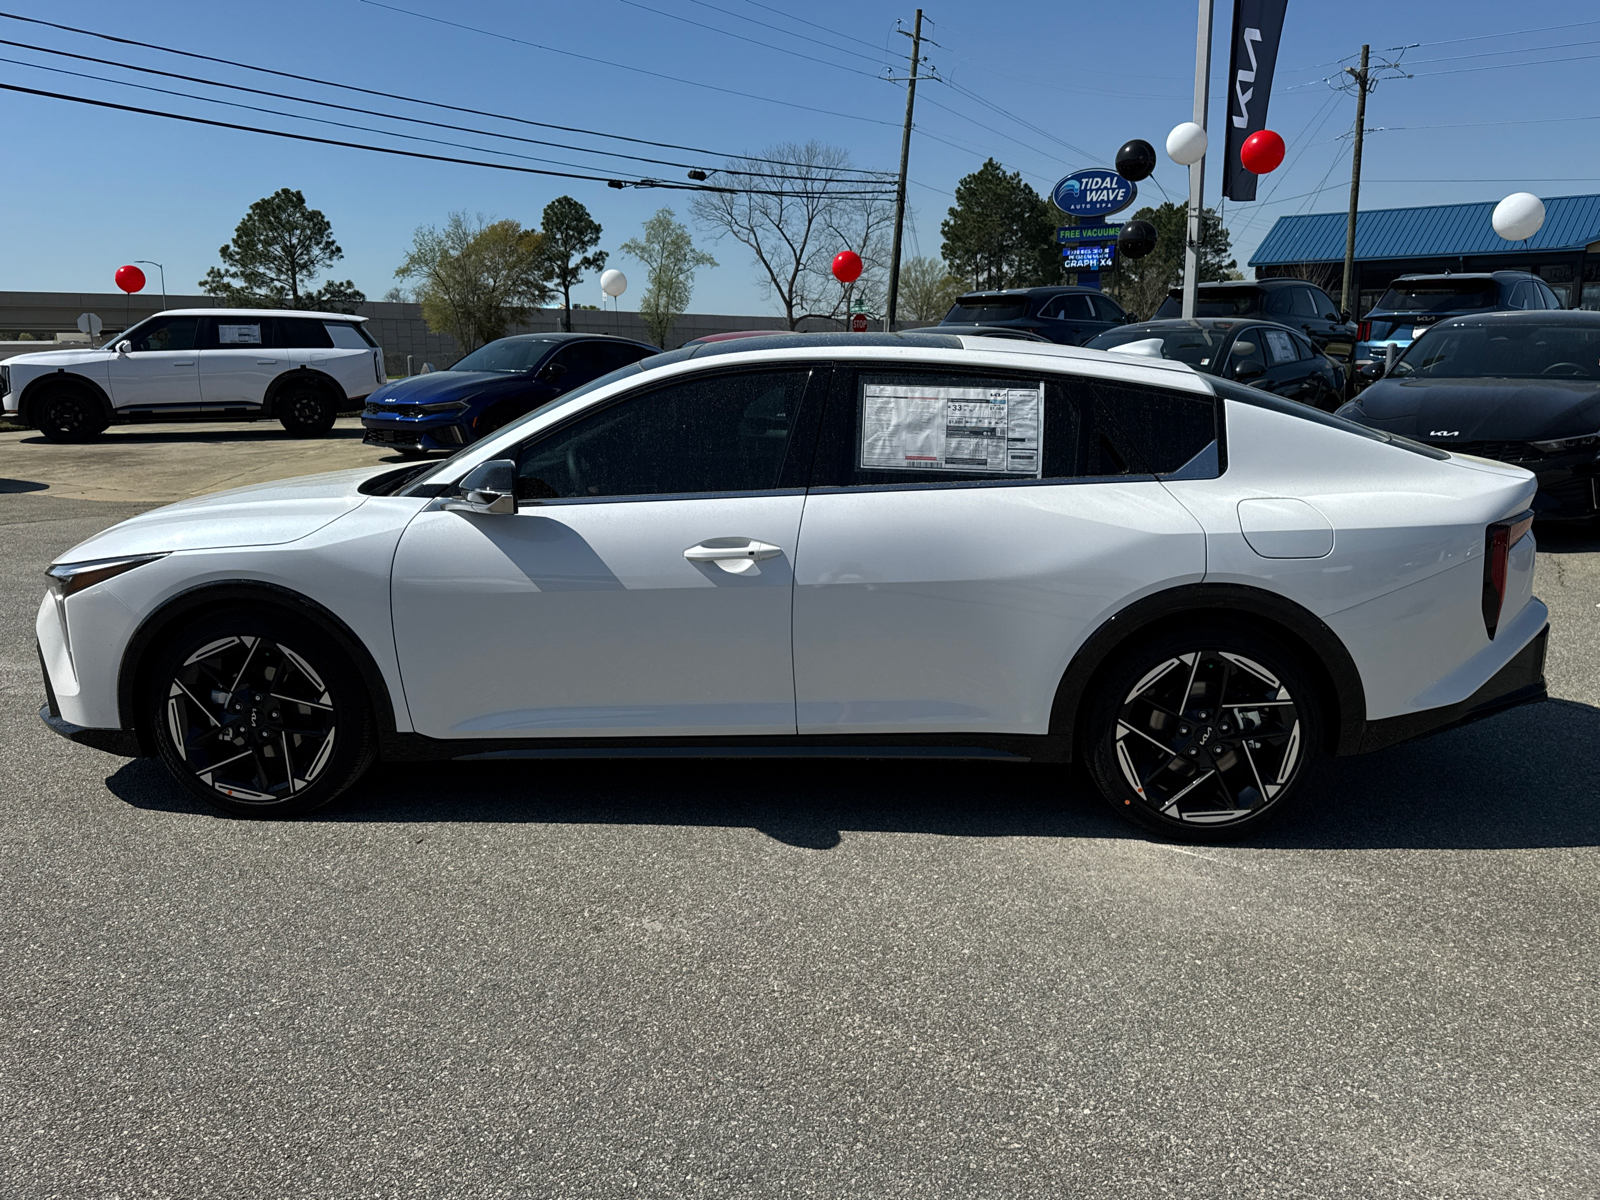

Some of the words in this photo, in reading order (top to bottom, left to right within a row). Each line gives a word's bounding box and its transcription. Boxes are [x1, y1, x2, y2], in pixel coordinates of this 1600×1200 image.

[1081, 177, 1118, 190] TIDAL
[1086, 189, 1126, 202] WAVE
[1060, 229, 1080, 239] FREE
[1082, 227, 1120, 237] VACUUMS
[853, 319, 867, 328] STOP
[952, 404, 962, 412] 33
